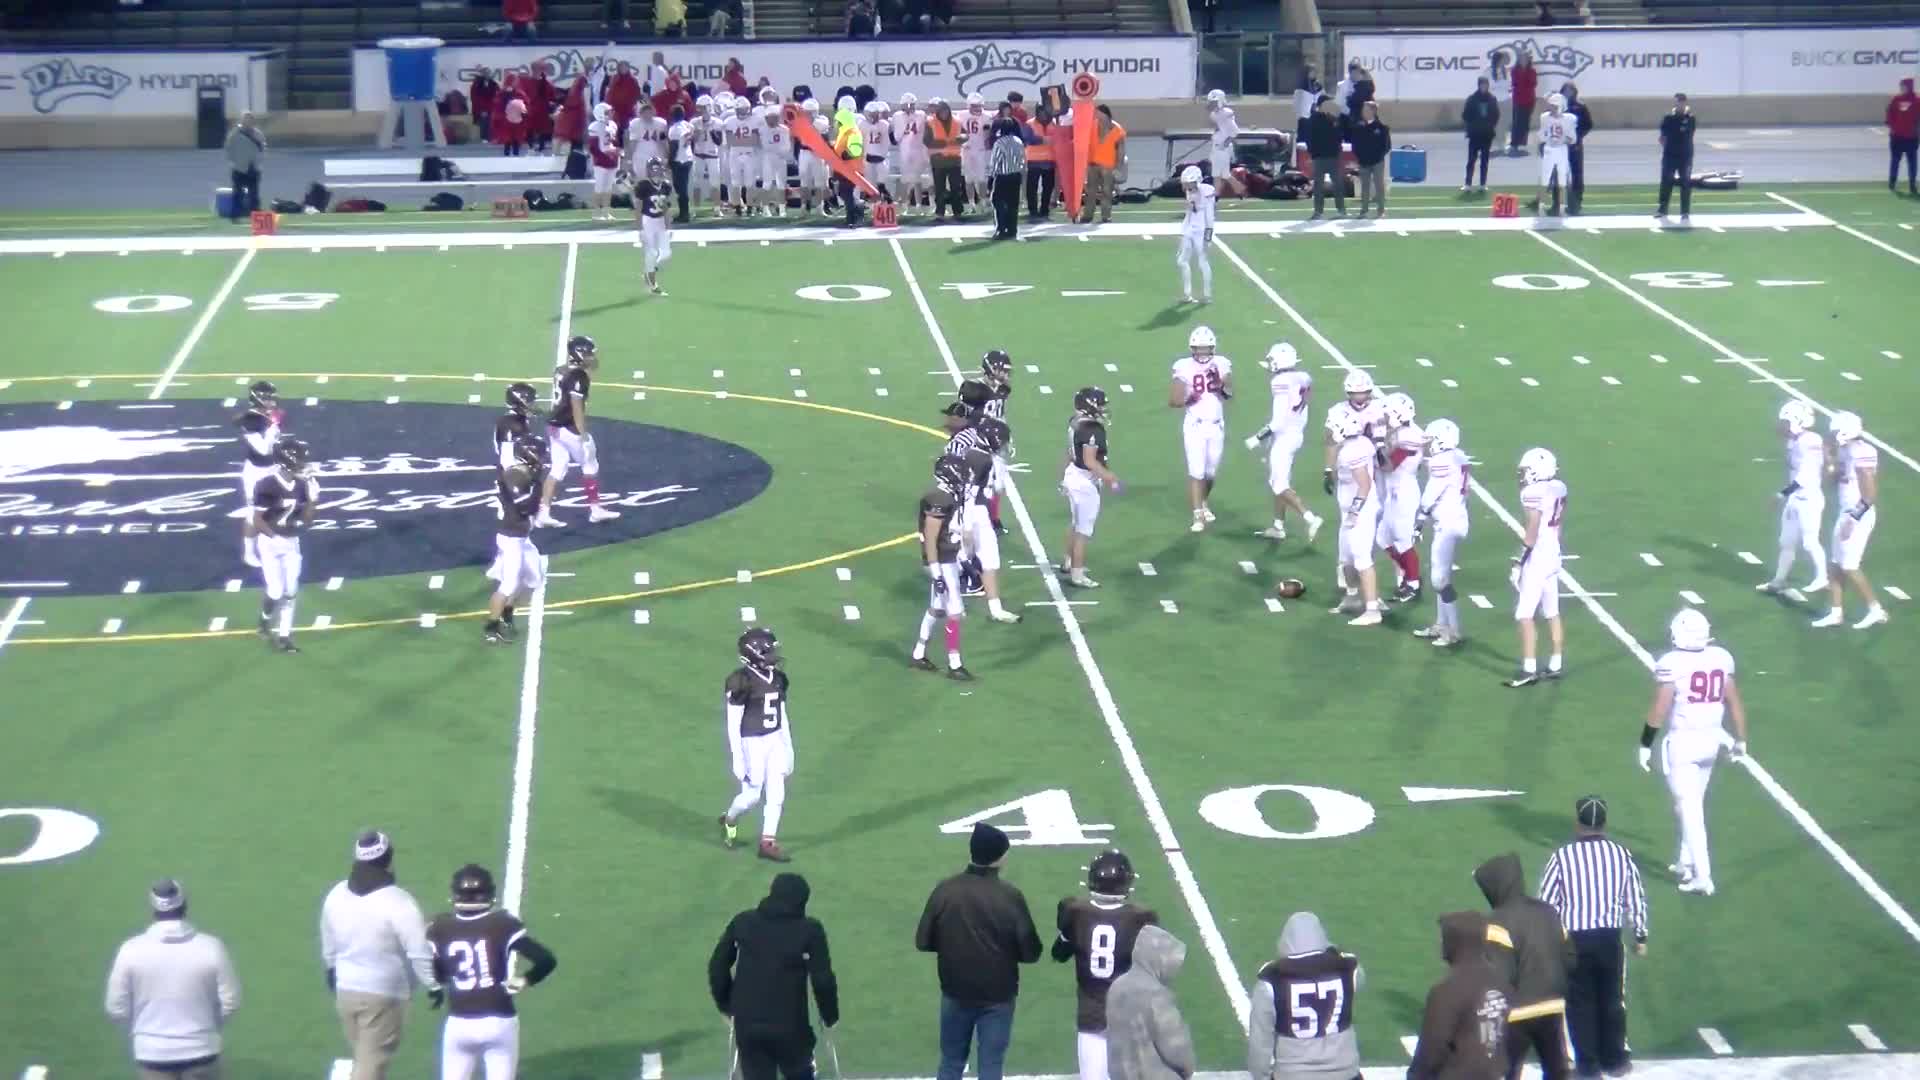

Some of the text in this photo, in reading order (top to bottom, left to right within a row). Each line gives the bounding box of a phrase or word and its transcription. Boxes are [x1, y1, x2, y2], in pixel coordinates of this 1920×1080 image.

[811, 63, 867, 79] BUICK
[874, 61, 941, 77] GMC
[1062, 57, 1161, 74] HYUNDAI
[1415, 56, 1481, 71] GMC
[1601, 52, 1698, 69] HYUNDAI
[1790, 50, 1920, 67] BUICK GMC
[139, 73, 238, 89] HYUNDAI
[876, 206, 896, 225] 40
[277, 499, 297, 527] 7
[1687, 668, 1725, 704] 90
[762, 691, 779, 729] 5
[447, 938, 494, 990] 31
[1090, 924, 1117, 979] 8
[1290, 978, 1344, 1040] 57
